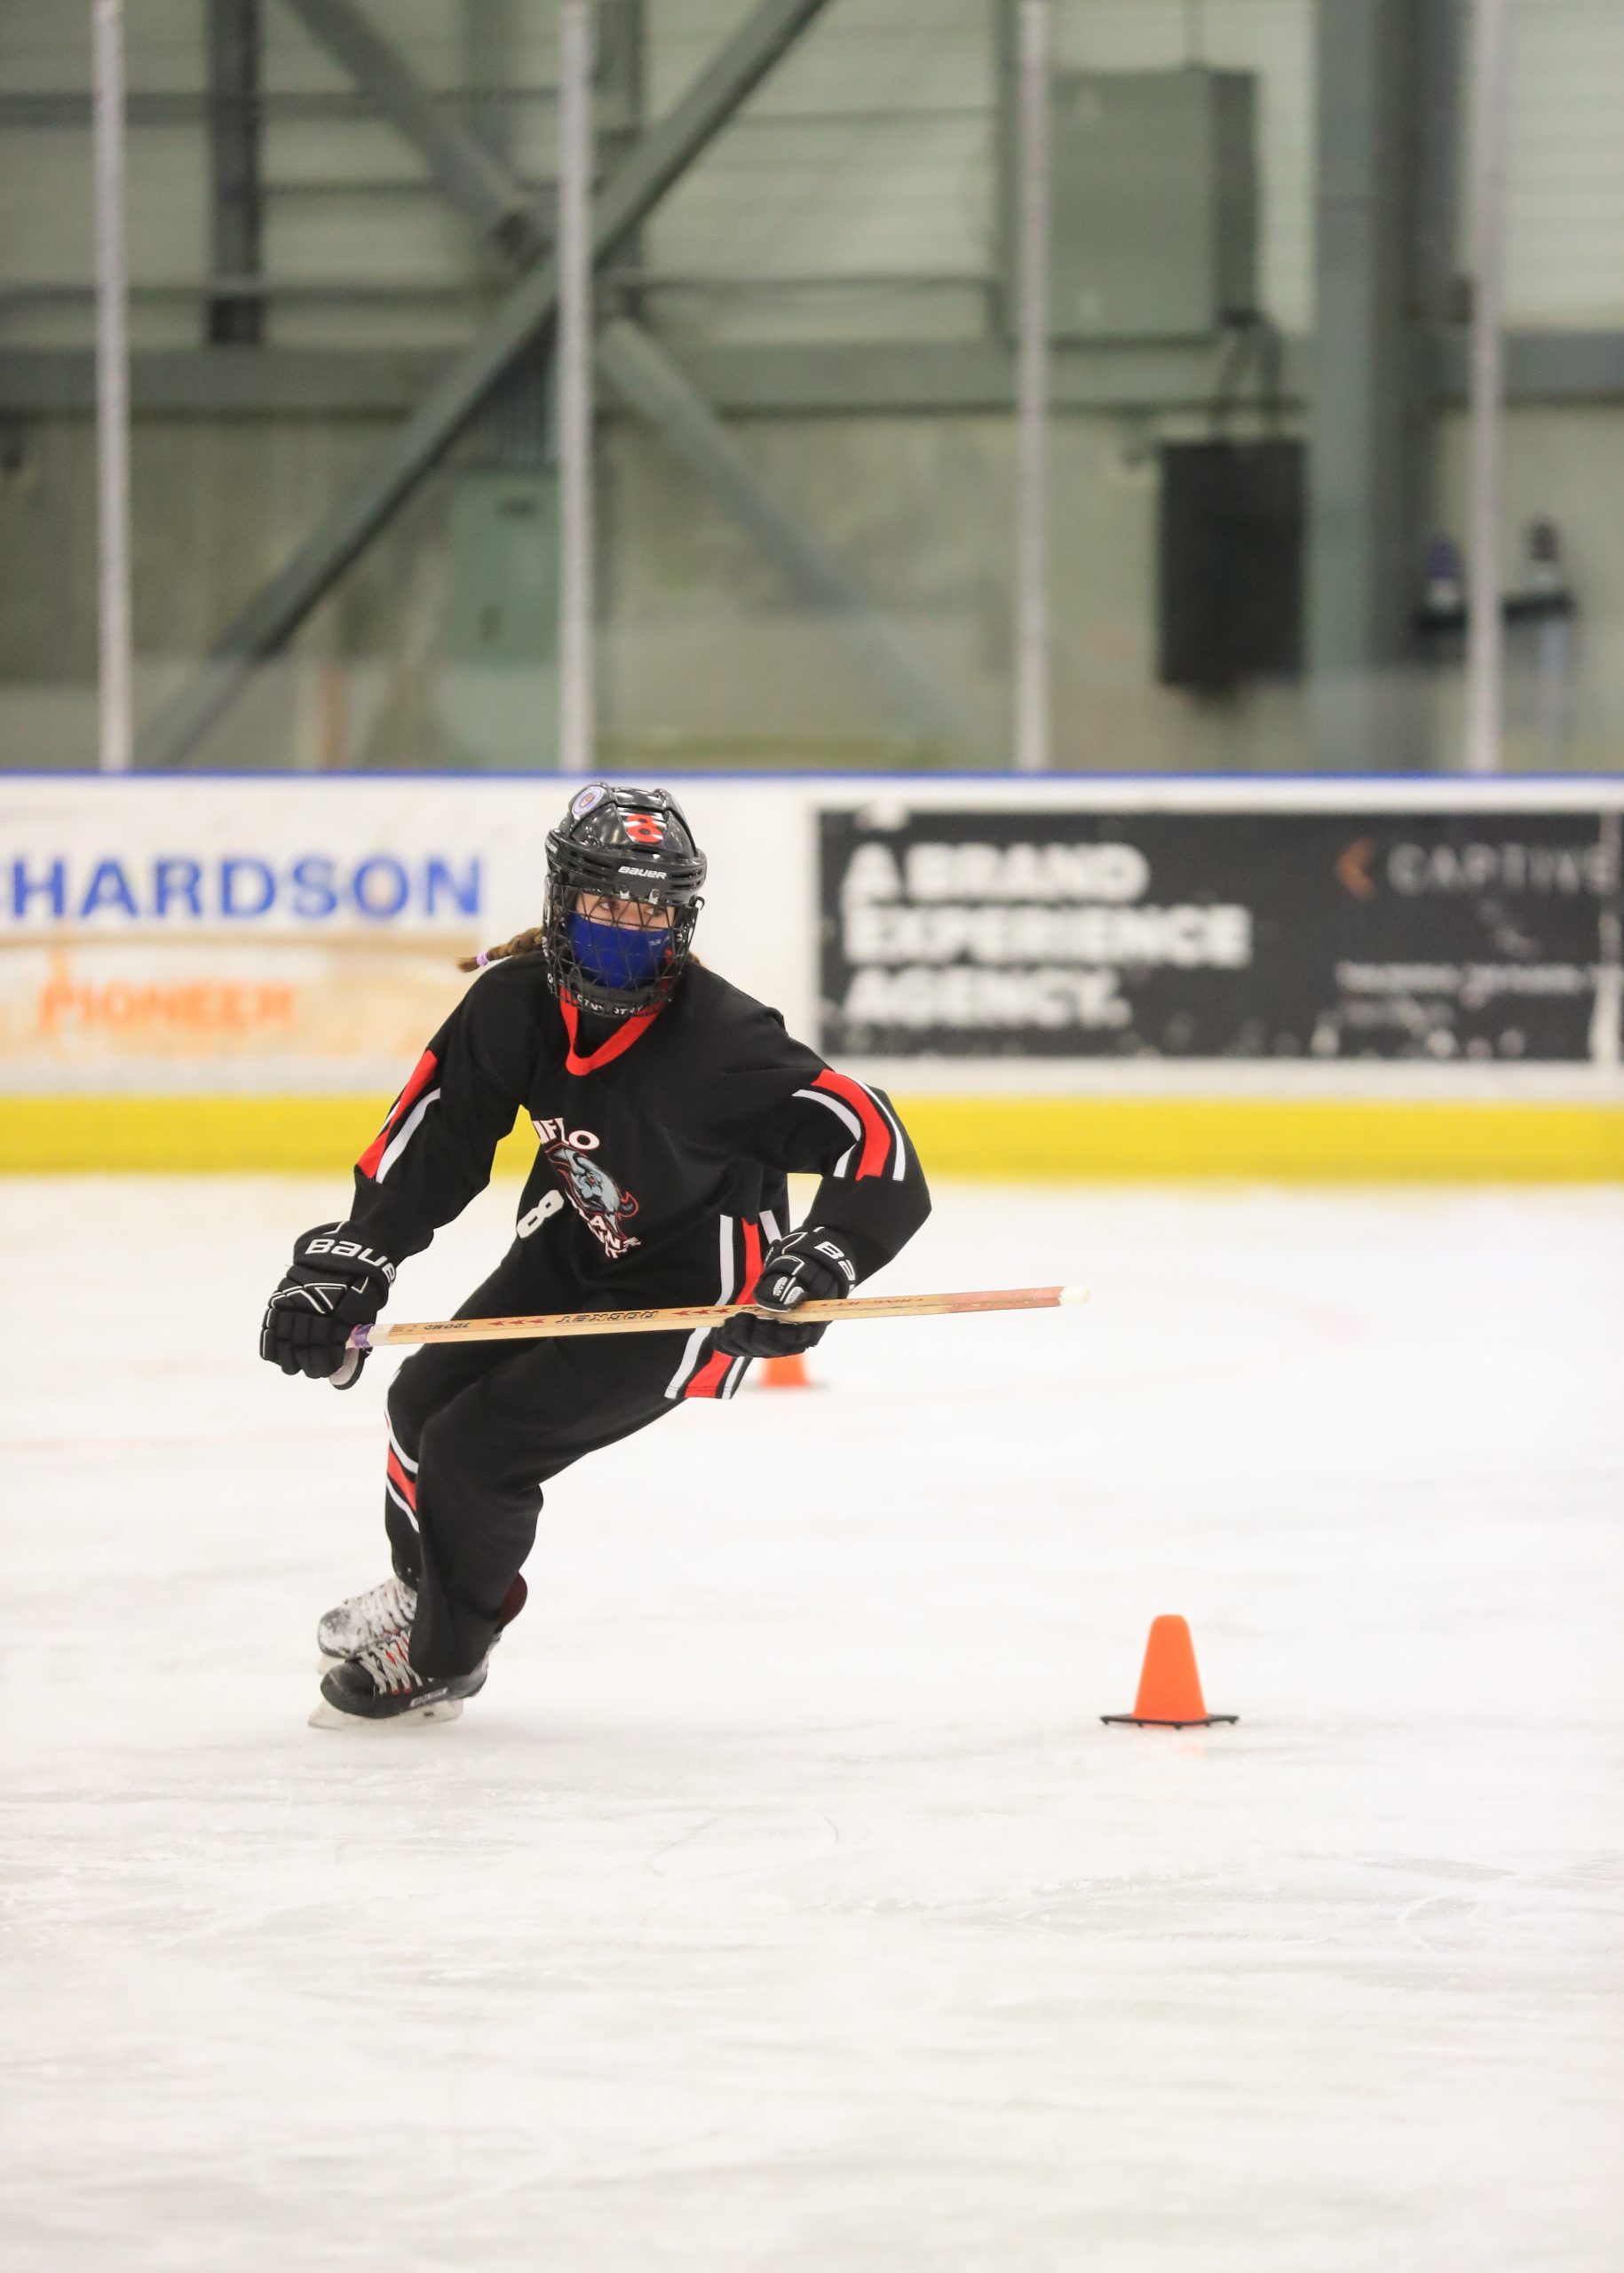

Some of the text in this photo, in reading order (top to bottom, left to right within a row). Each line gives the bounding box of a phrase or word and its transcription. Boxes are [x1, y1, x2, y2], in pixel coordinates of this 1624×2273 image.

[623, 810, 666, 844] 8
[0, 855, 481, 920] HARDSON
[842, 842, 1150, 901] A BRAND
[844, 904, 1252, 968] EXPERIENCE
[517, 1190, 564, 1239] 8
